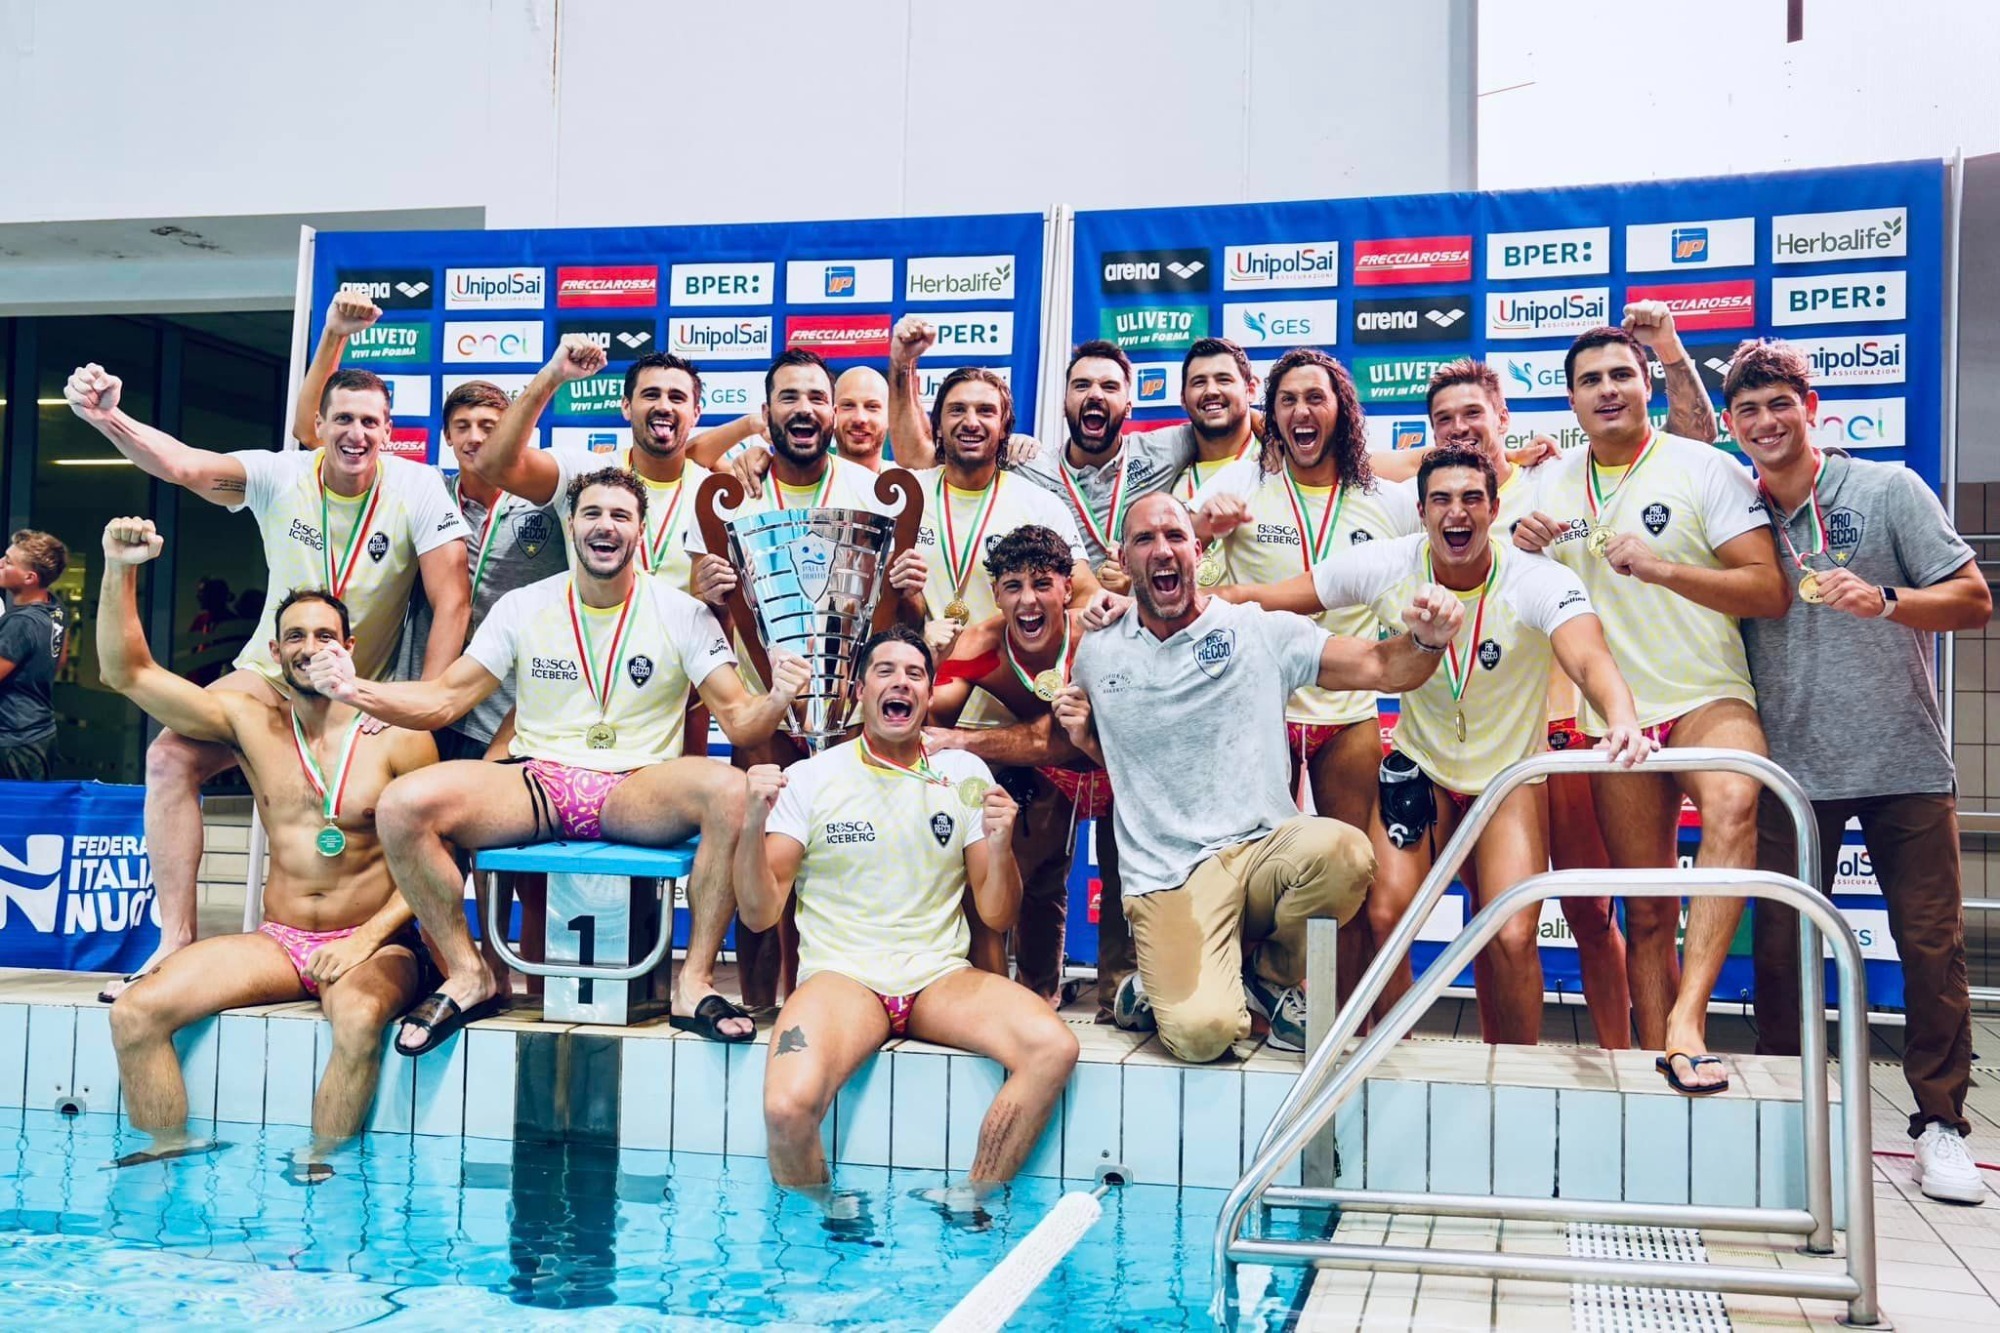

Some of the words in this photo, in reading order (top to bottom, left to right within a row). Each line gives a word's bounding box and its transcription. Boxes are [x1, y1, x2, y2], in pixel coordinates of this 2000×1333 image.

[1777, 226, 1892, 255] Herbalife
[1236, 249, 1333, 280] UnipolSai
[1358, 250, 1469, 266] FRECCIAROSSA
[1104, 262, 1160, 281] arena
[457, 273, 541, 302] UnipolSai
[561, 279, 656, 290] FRECCIAROSSA
[909, 272, 1002, 293] Herbalife
[1499, 295, 1604, 328] UnipolSai
[1664, 296, 1752, 311] CCIAROSSA
[1116, 311, 1192, 332] ULIVETO
[1271, 319, 1311, 335] GES
[1357, 310, 1418, 330] arena
[350, 328, 417, 346] ULIVETO
[457, 328, 529, 355] enel
[680, 323, 768, 351] UnipolSai
[790, 328, 889, 340] FRECCIAROSSA
[938, 324, 998, 343] PER:
[1118, 335, 1138, 346] VIVI
[1151, 332, 1189, 343] FORMA
[351, 350, 370, 359] VIVI
[382, 347, 416, 357] FORMA
[1807, 342, 1900, 377] nipolSai
[1538, 370, 1566, 386] GE
[570, 379, 625, 398] ULIVET
[711, 388, 747, 403] GES
[1370, 387, 1394, 397] VIVI
[570, 402, 591, 411] VIVI
[1819, 407, 1884, 441] nel
[379, 441, 426, 451] AROSSA
[525, 514, 543, 527] PRO
[1831, 513, 1850, 529] PRO
[518, 526, 547, 540] RECCO
[1257, 534, 1300, 546] ICEBERG
[1826, 528, 1857, 545] RECCO
[1198, 642, 1231, 661] RECCO
[532, 657, 576, 670] BOSCA
[531, 668, 578, 680] ICEBERG
[827, 821, 874, 834] BOSCA
[72, 835, 147, 856] FEDERA
[827, 833, 875, 844] ICEBERG
[68, 859, 153, 890] ITALI
[567, 915, 595, 1005] 1
